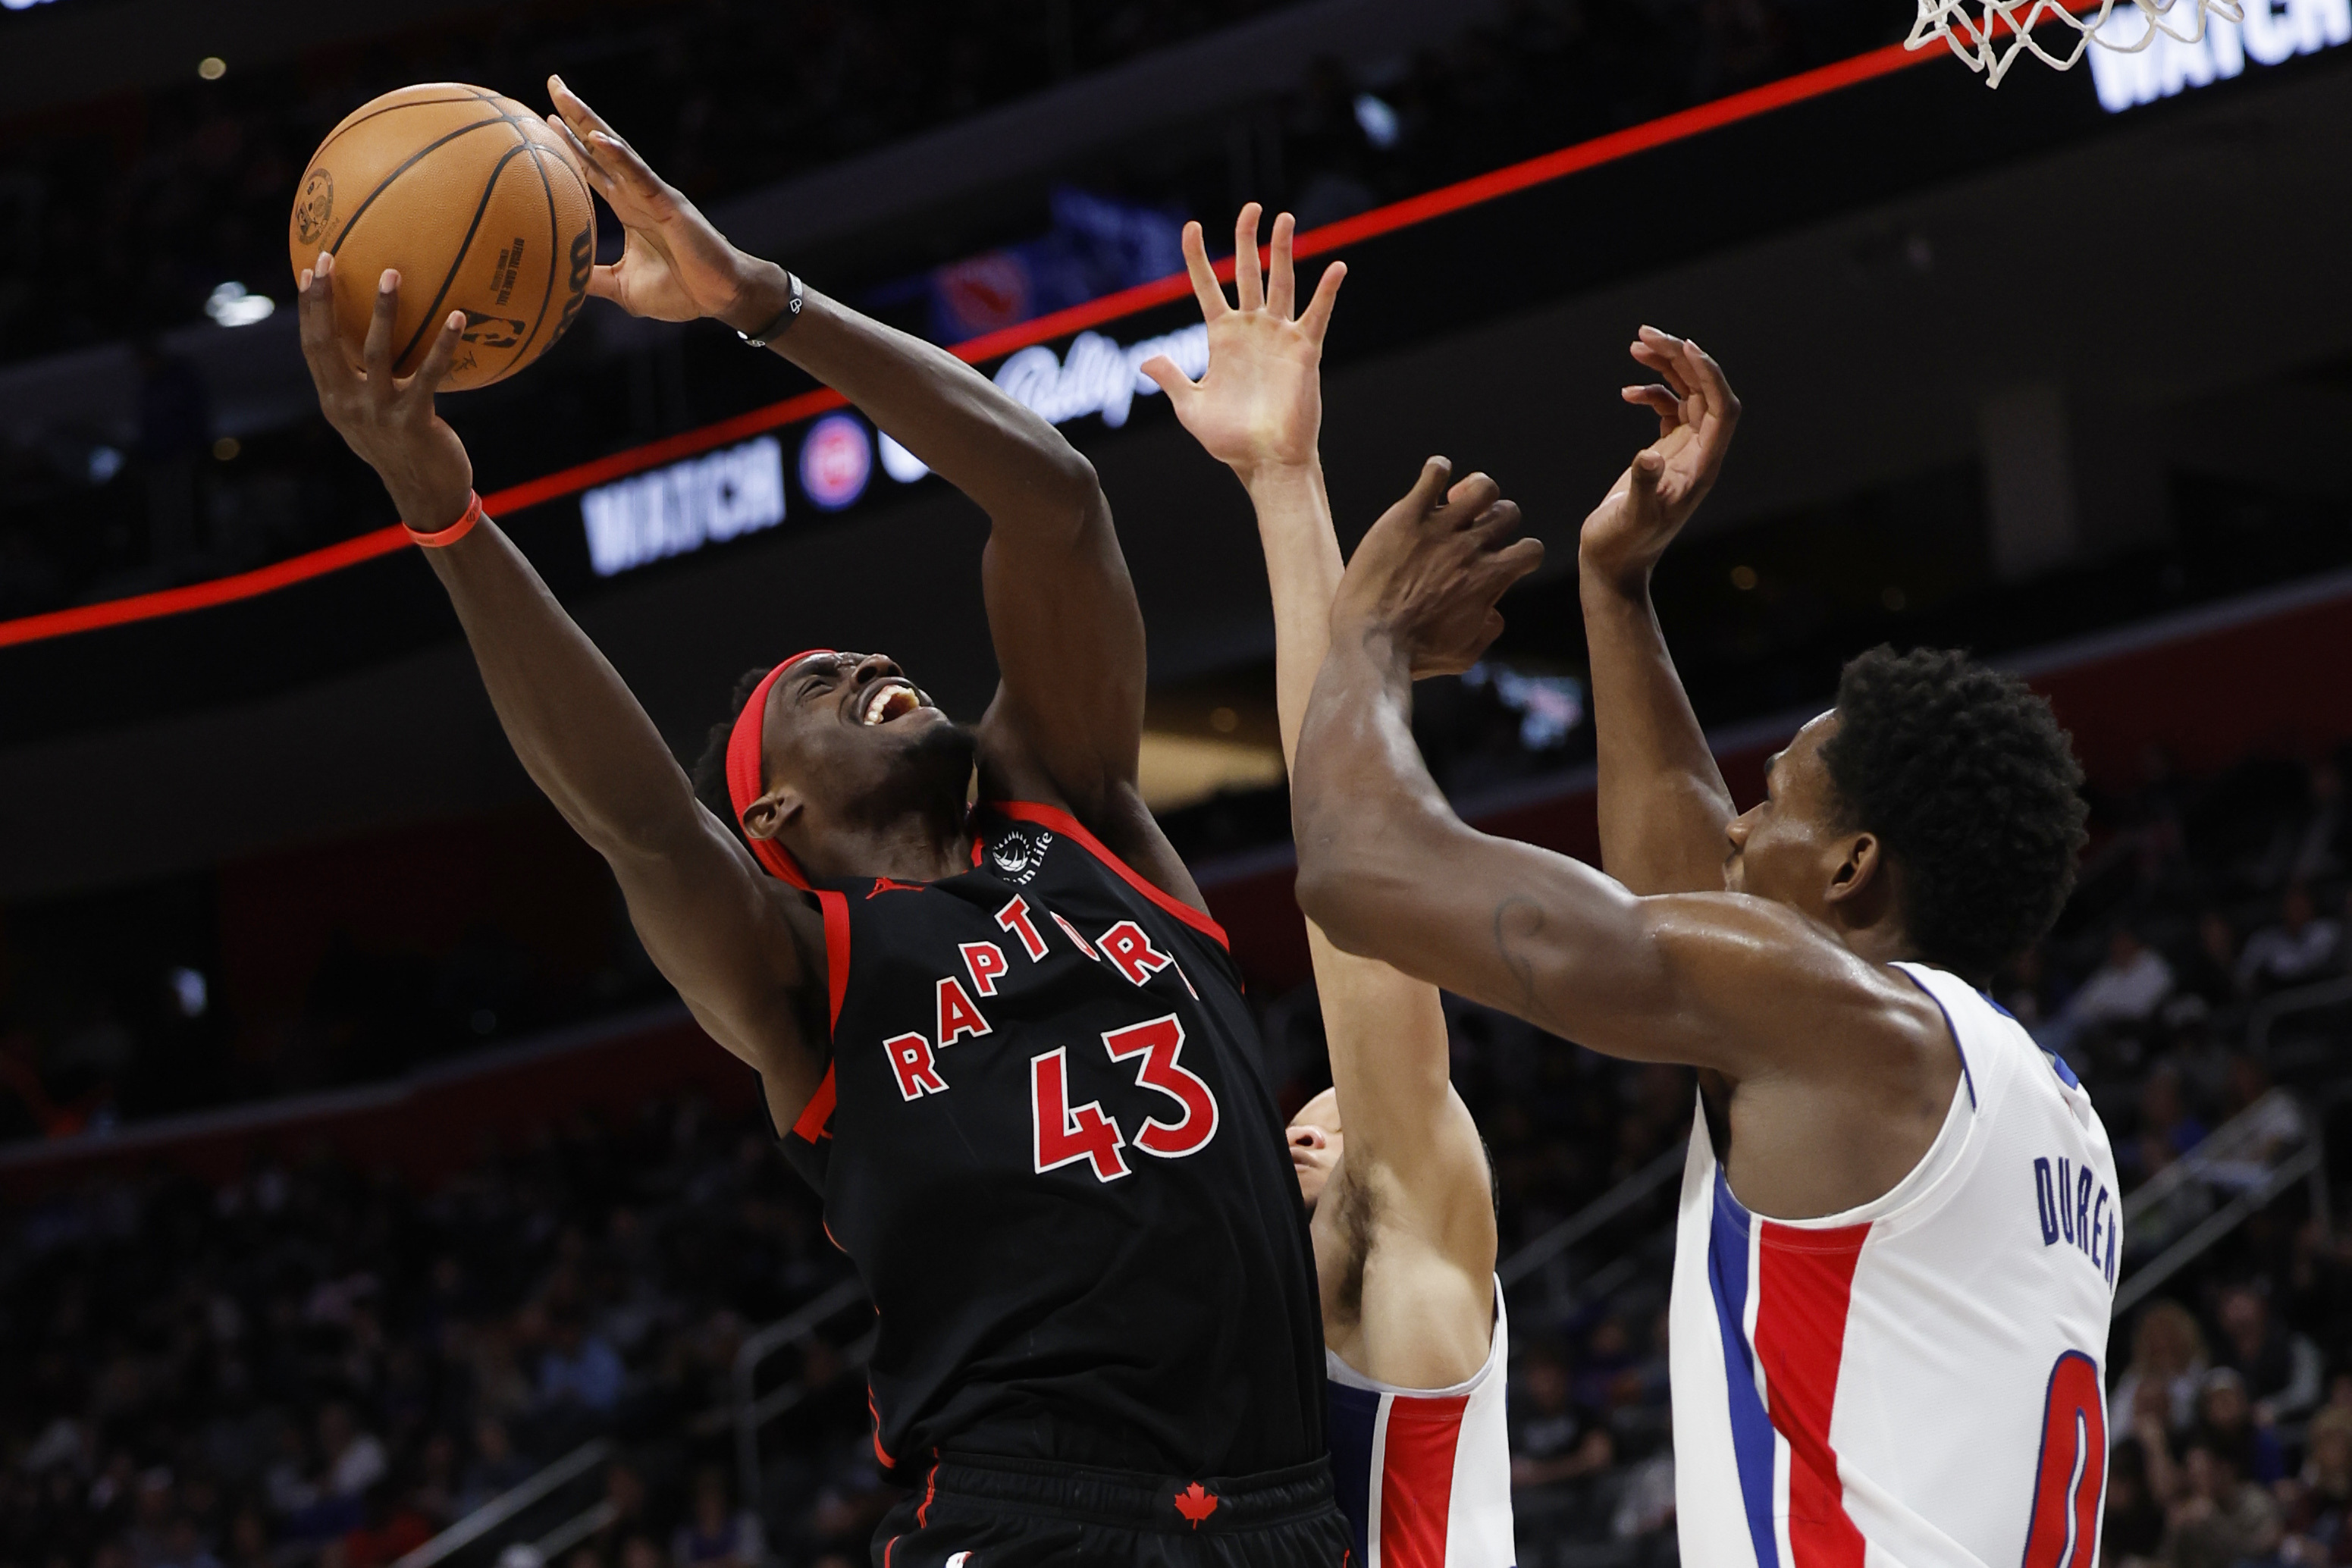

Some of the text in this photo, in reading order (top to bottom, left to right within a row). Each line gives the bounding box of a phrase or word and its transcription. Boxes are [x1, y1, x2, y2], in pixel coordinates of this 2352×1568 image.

[580, 434, 786, 577] WATCH
[1030, 832, 1053, 867] Life
[1030, 1013, 1219, 1183] 43
[2034, 1156, 2115, 1295] DUREN
[2021, 1349, 2106, 1568] 0
